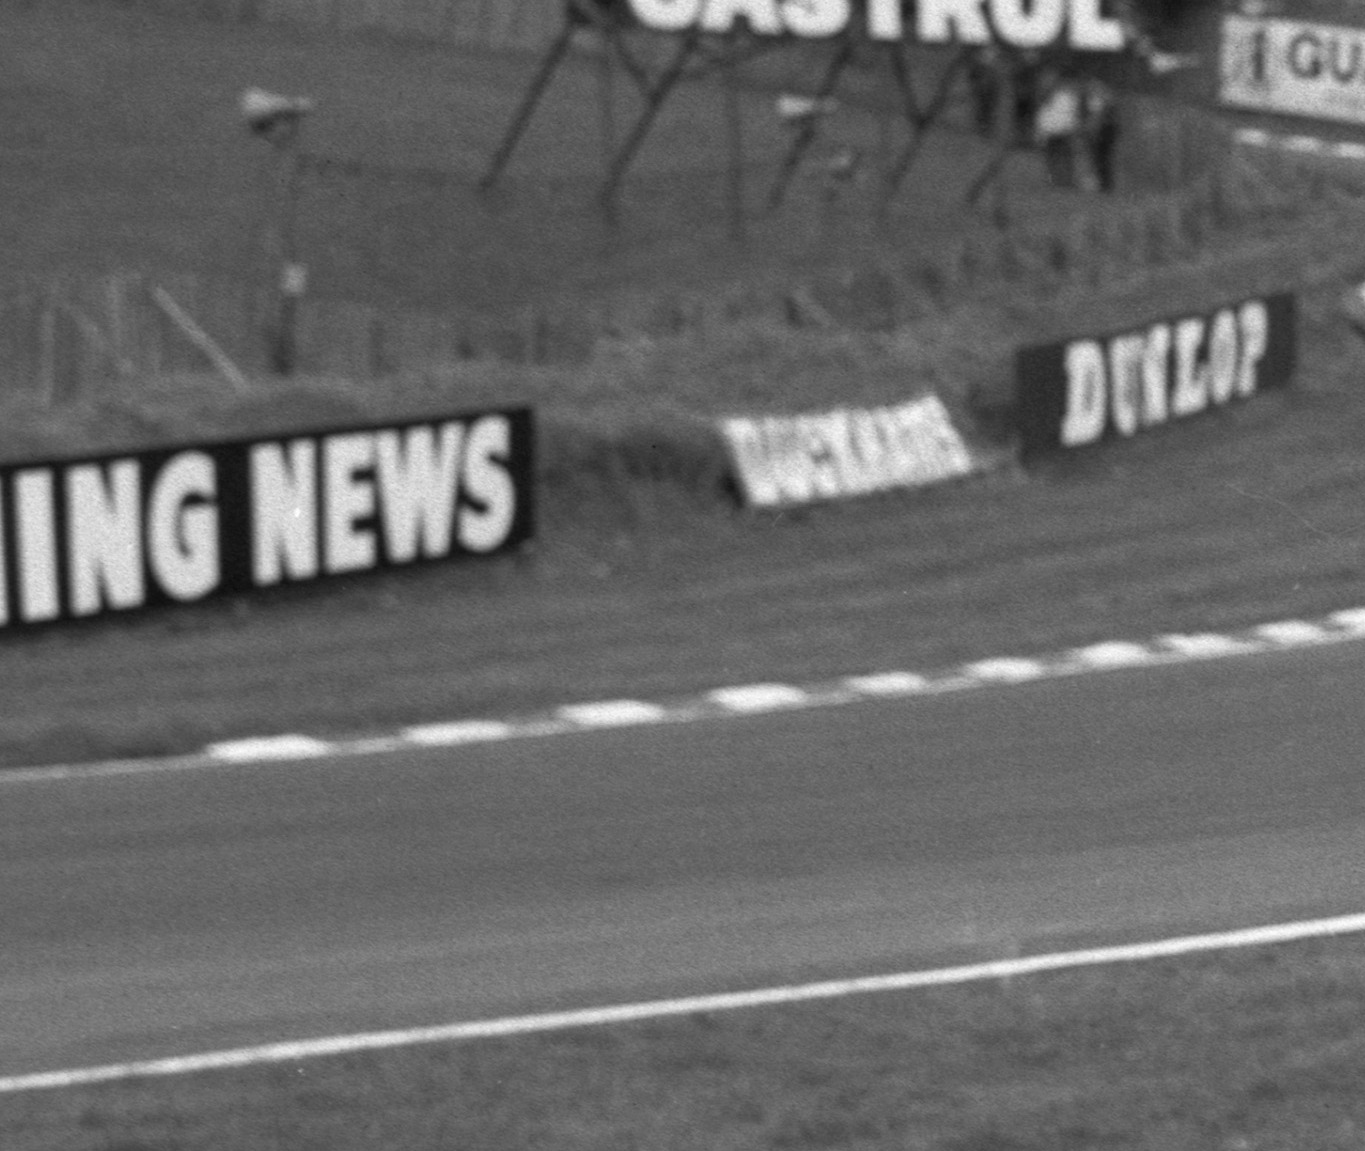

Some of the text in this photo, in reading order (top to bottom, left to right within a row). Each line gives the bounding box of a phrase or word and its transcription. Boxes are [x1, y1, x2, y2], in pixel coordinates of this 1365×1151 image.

[1060, 301, 1268, 447] DUNLOP
[0, 415, 516, 626] ING NEWS
